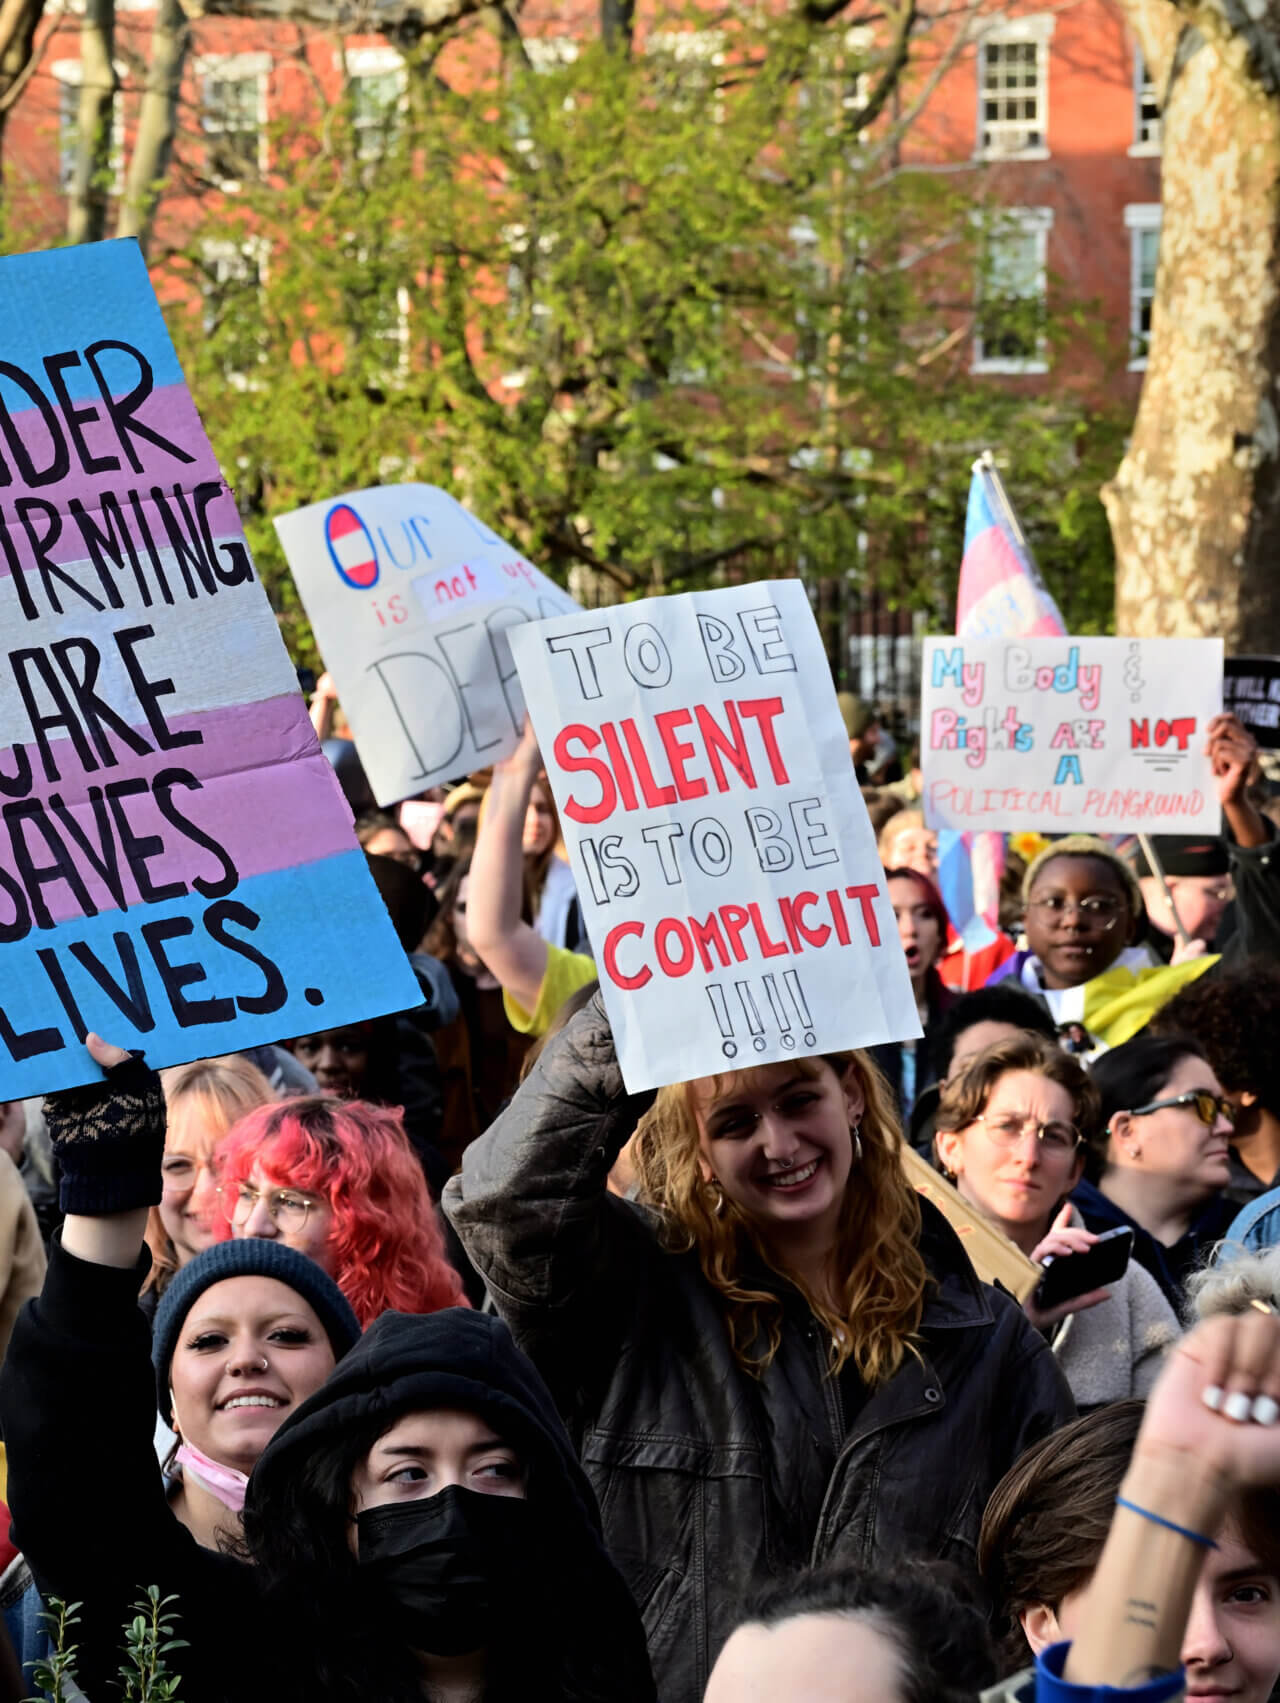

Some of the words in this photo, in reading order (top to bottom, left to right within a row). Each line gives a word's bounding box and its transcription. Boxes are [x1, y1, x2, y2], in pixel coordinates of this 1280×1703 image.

[371, 594, 409, 627] is
[434, 564, 480, 605] not
[546, 623, 672, 700] TO
[697, 605, 798, 683] BE
[931, 647, 985, 707] My
[1004, 646, 1101, 711] Body
[554, 696, 789, 824] SILENT
[931, 706, 1034, 768] Rights
[1050, 719, 1105, 750] ARE
[1131, 717, 1197, 750] NOT
[929, 780, 1073, 817] POLITICAL
[1081, 789, 1206, 819] PLAYGROUND
[1054, 755, 1083, 785] A
[580, 835, 640, 905] IS
[642, 817, 733, 885] TO
[745, 797, 840, 873] BE
[603, 884, 881, 991] COMPLICIT
